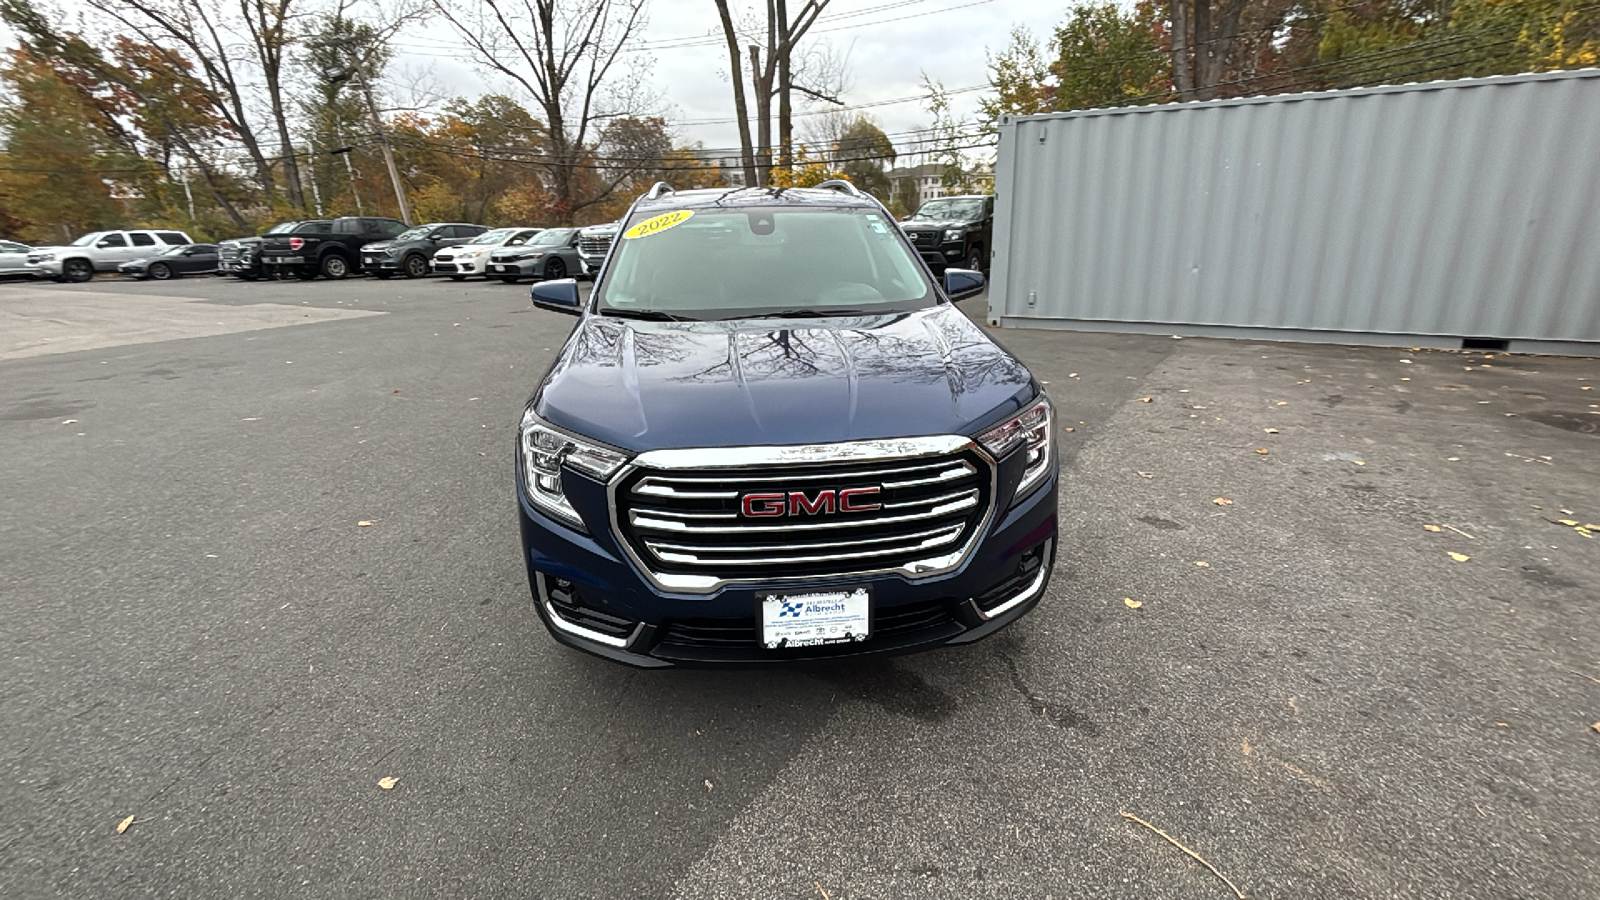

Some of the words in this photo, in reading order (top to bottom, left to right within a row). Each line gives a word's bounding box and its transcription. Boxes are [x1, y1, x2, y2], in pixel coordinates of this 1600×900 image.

[638, 213, 682, 235] 2022
[742, 486, 881, 517] GMC
[805, 603, 846, 613] Albrecht
[785, 638, 824, 648] Albrecht
